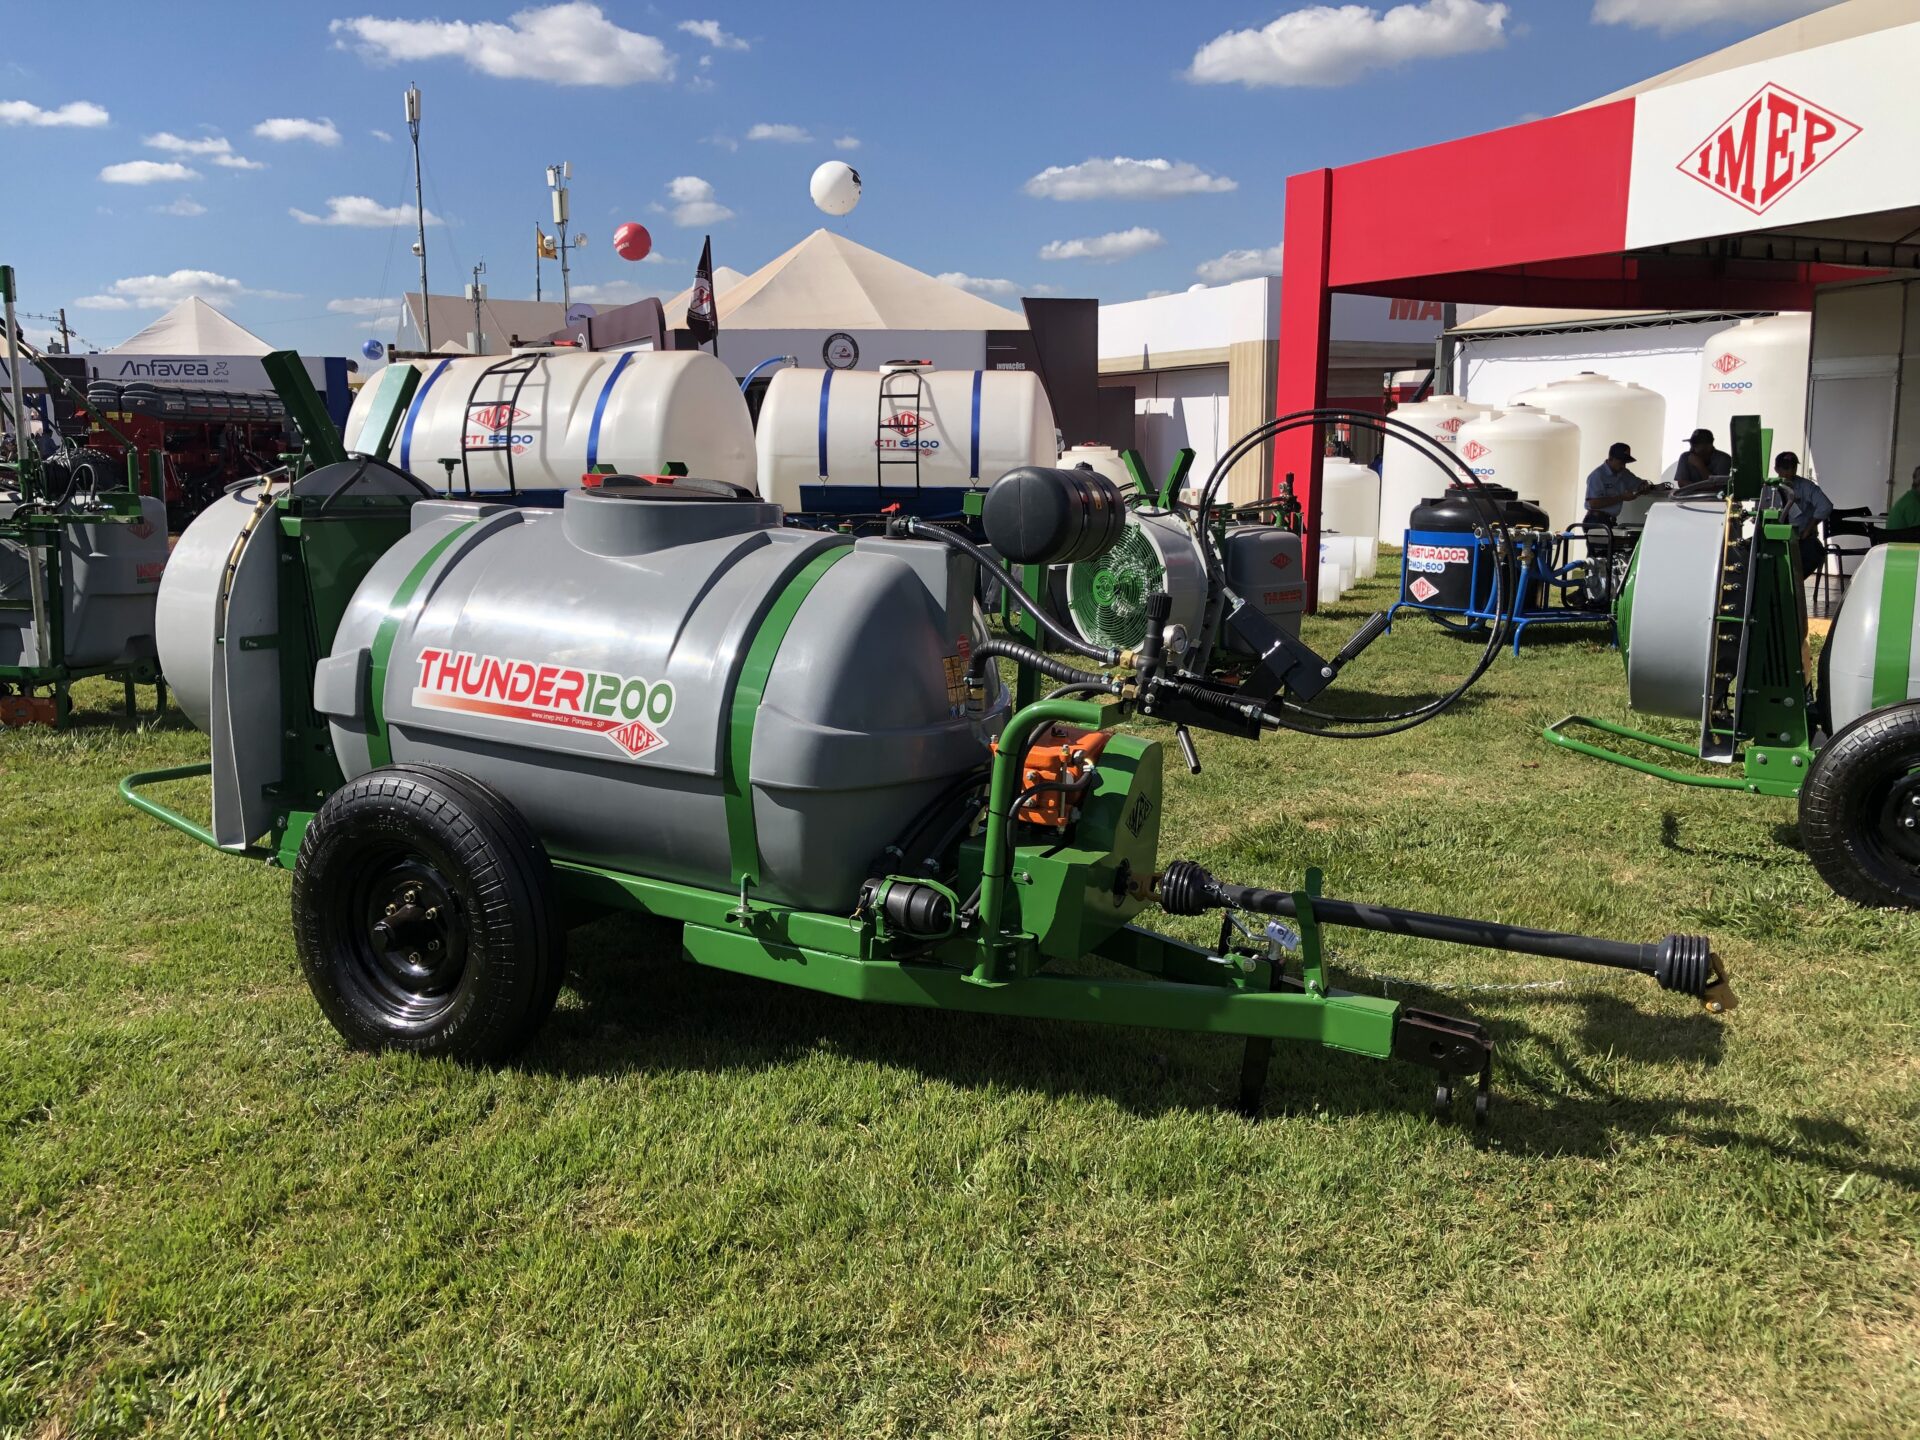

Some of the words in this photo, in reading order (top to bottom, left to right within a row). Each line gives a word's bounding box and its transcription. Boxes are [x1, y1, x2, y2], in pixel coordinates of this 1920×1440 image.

[1698, 92, 1836, 206] IMEP
[119, 359, 208, 376] Anfavea
[1716, 355, 1740, 372] IMEP
[476, 404, 522, 429] IMEP
[888, 413, 926, 435] IMEP
[459, 435, 484, 444] CTI
[900, 440, 939, 448] 6400
[531, 712, 569, 723] www.imep.ind.br
[597, 720, 605, 728] SP
[616, 722, 655, 755] IMEP
